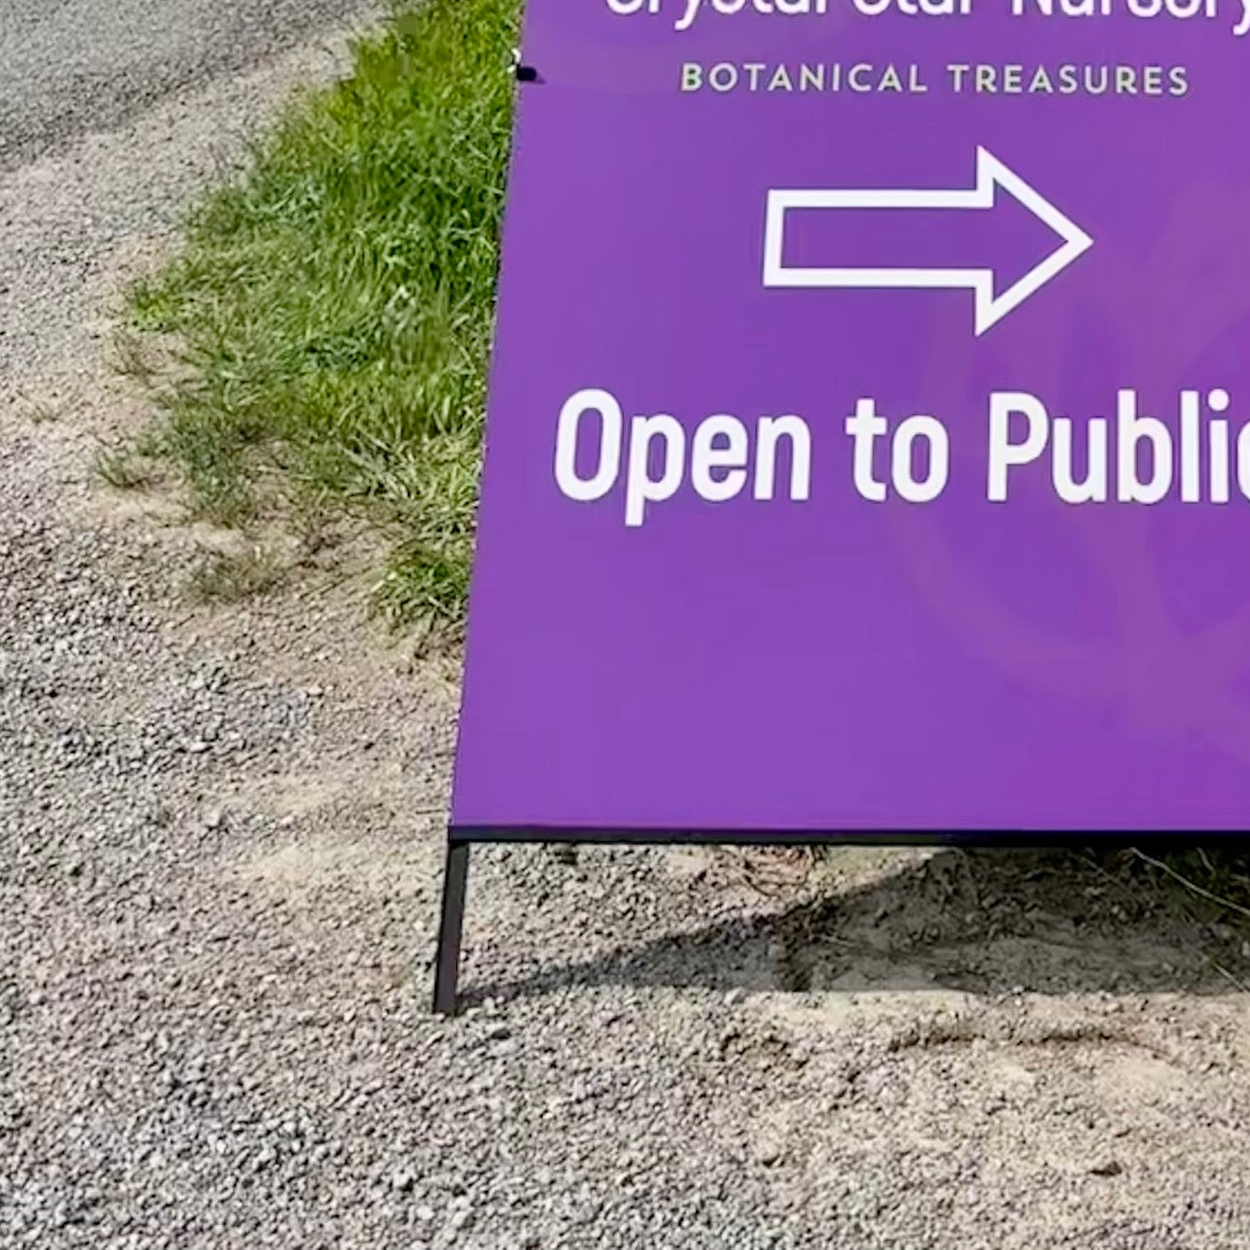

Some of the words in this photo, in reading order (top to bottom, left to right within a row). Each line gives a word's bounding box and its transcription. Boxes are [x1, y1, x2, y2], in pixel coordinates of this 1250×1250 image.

[681, 62, 928, 92] BOTANICAL
[947, 64, 1188, 96] TREASURES
[554, 388, 811, 527] Open
[845, 398, 949, 503] to
